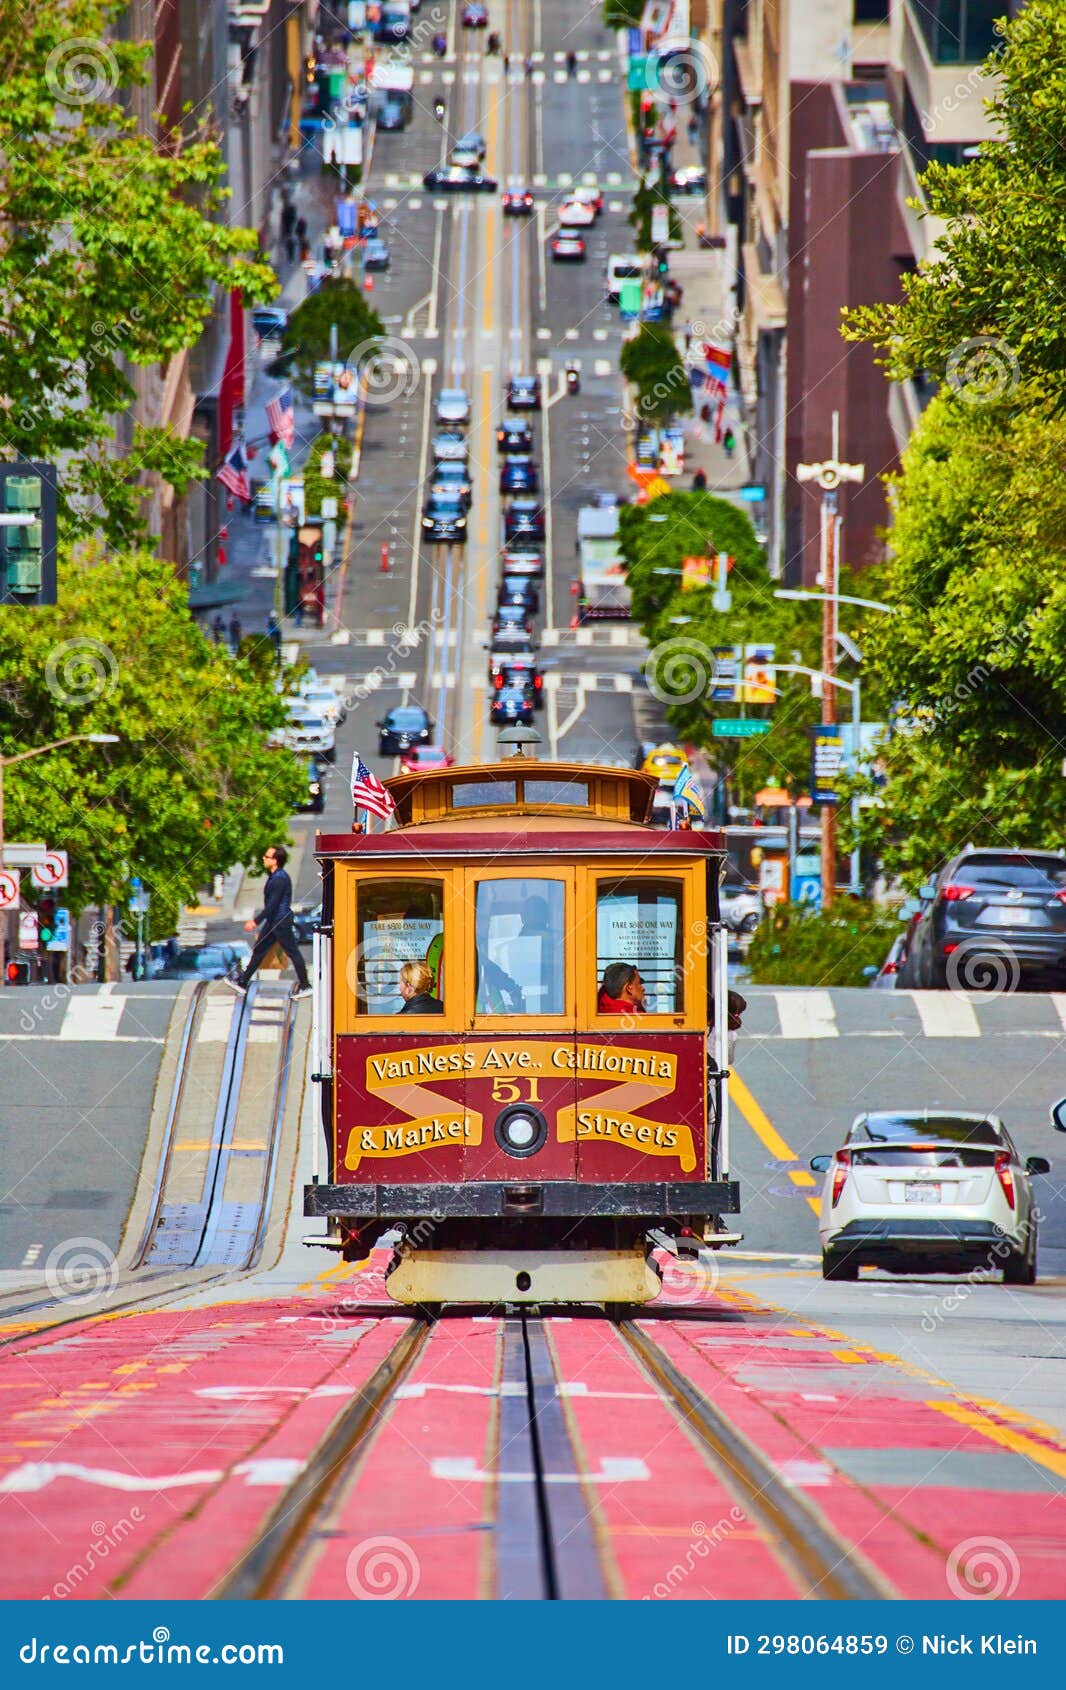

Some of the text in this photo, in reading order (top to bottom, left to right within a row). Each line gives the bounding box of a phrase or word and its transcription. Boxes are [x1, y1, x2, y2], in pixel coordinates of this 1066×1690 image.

[612, 921, 627, 929] FARE
[645, 921, 657, 929] ONE
[659, 921, 674, 929] WAY
[372, 1057, 413, 1080] Van
[418, 1052, 474, 1075] Ness
[551, 1047, 673, 1079] California
[491, 1077, 543, 1104] 51
[360, 1116, 472, 1151] & Market
[576, 1112, 679, 1148] Streets
